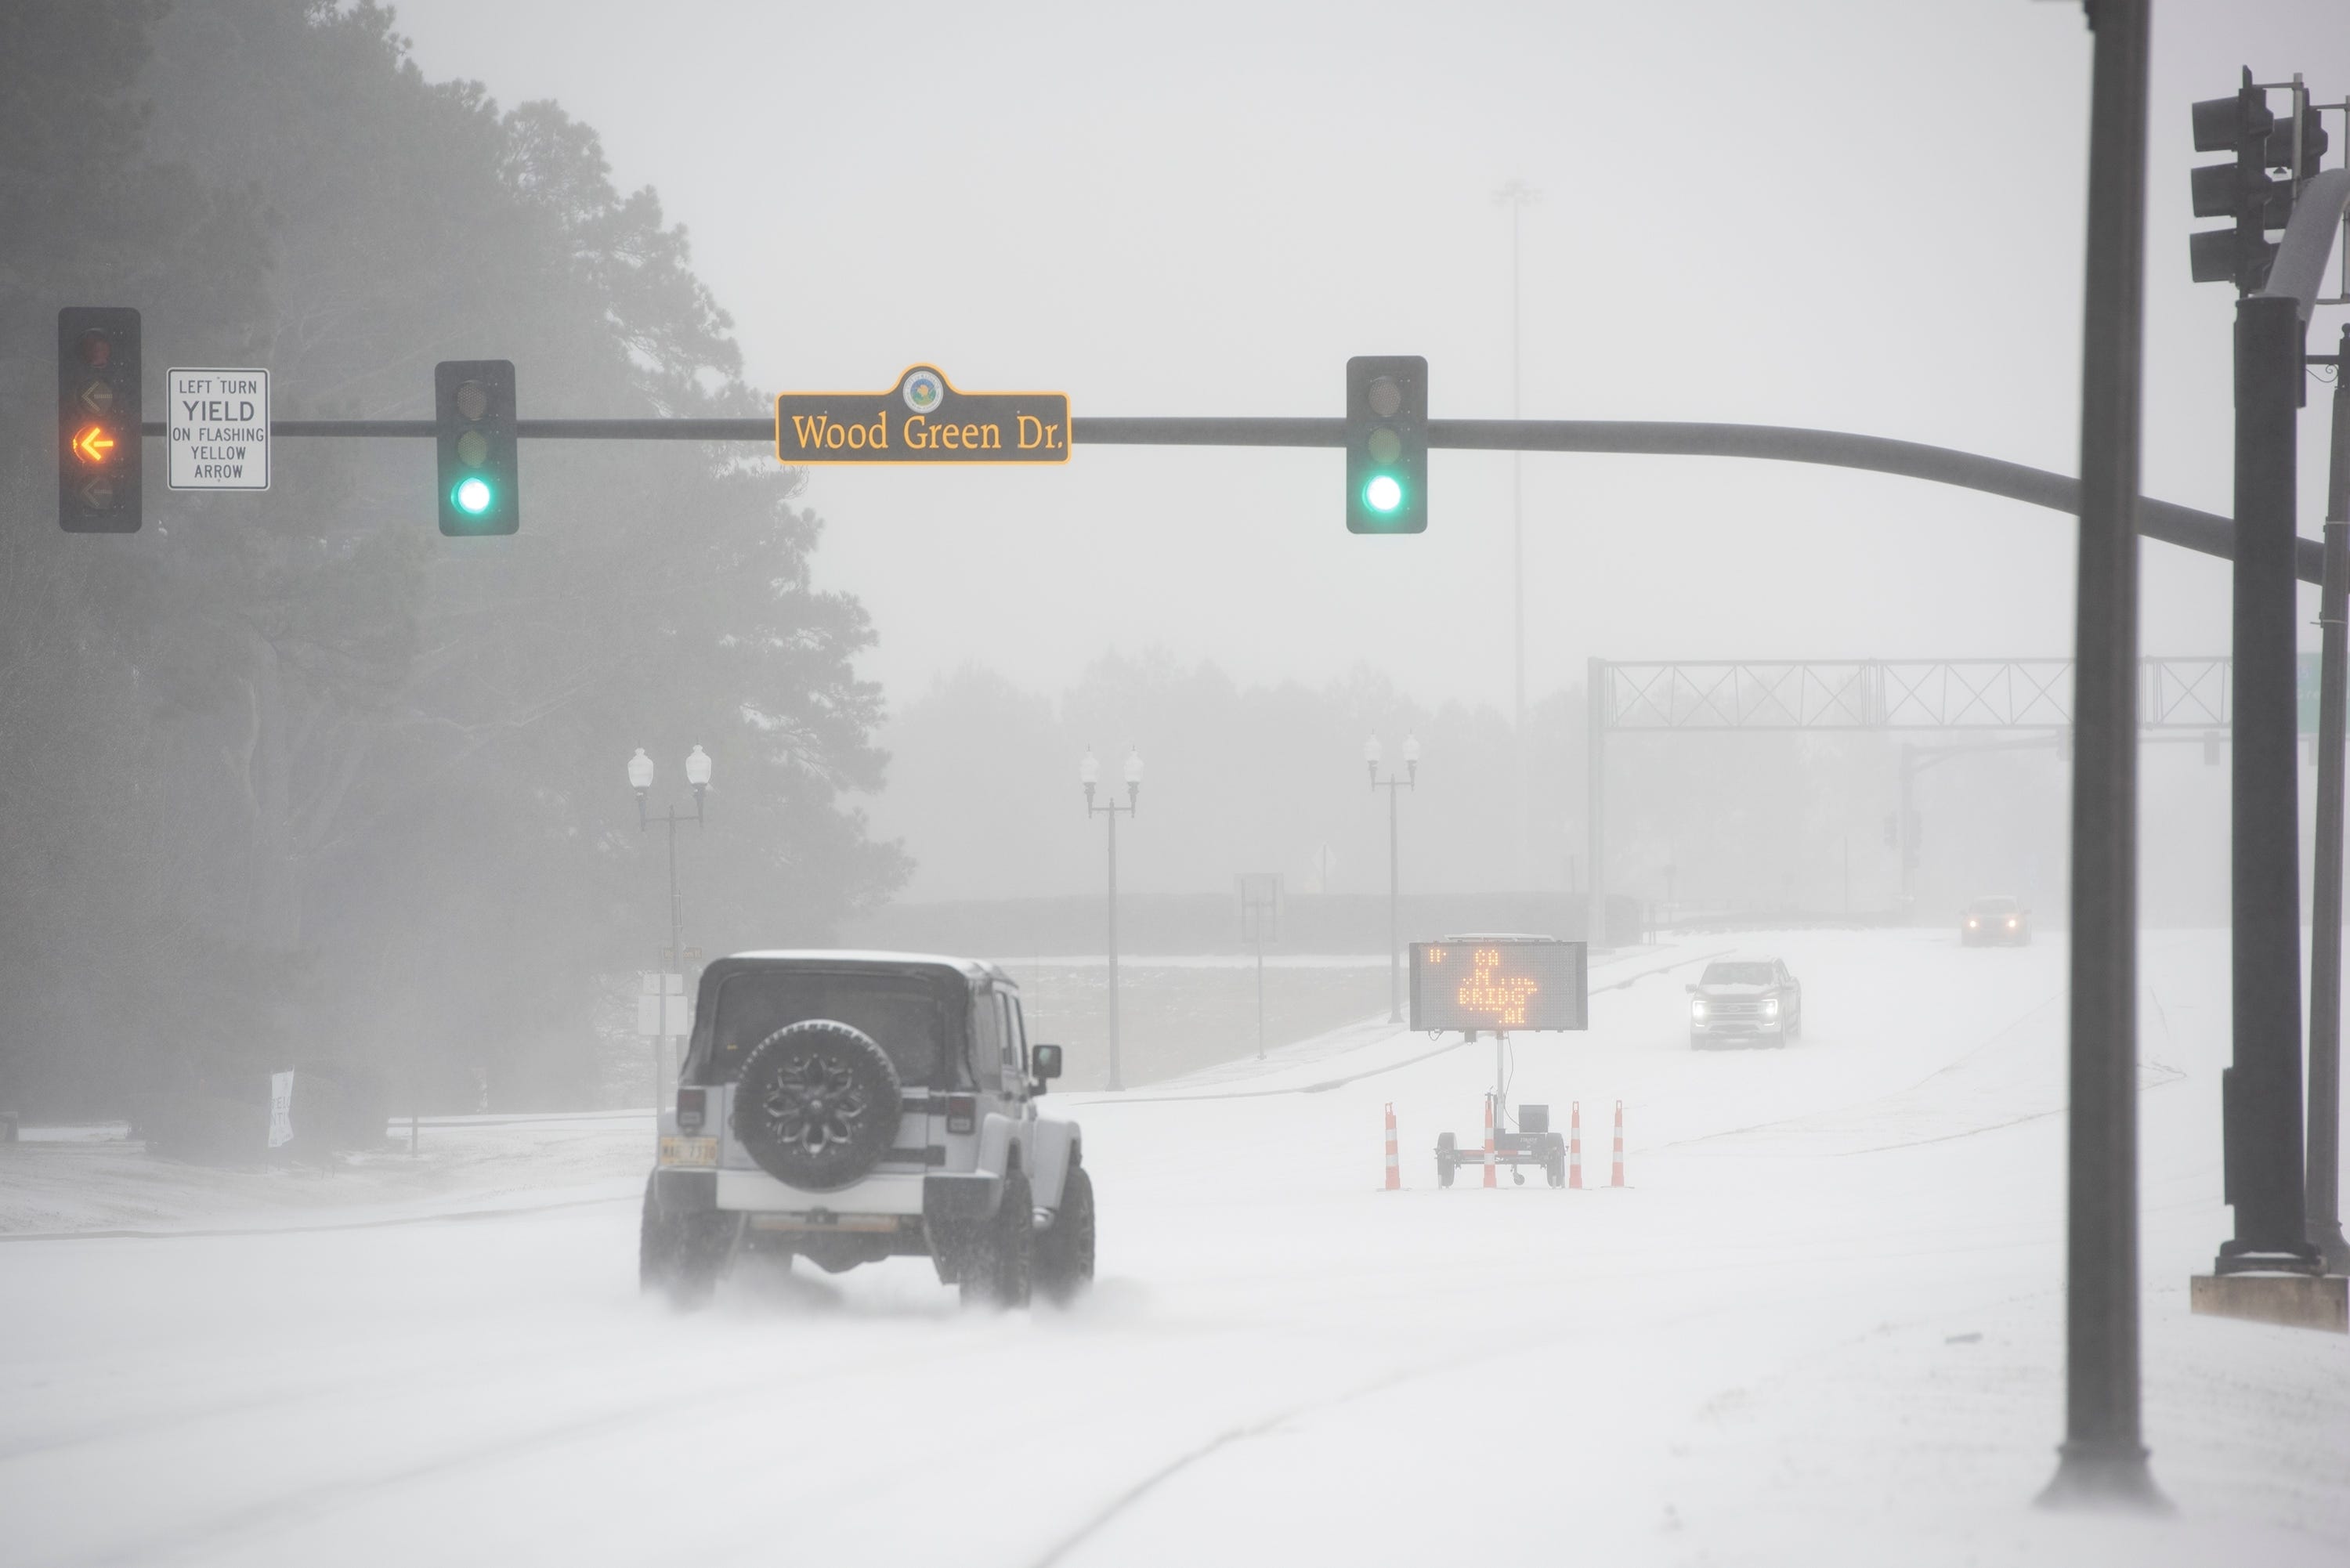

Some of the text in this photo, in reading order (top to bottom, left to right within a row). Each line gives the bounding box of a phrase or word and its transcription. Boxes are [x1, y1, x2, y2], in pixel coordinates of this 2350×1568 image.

[179, 380, 257, 394] LEFT TURN
[183, 400, 255, 421] YIELD
[172, 427, 264, 442] ON FLASHING
[792, 411, 1063, 449] Wood Green Dr.
[191, 446, 246, 460] YELLOW
[194, 464, 243, 479] ARROW
